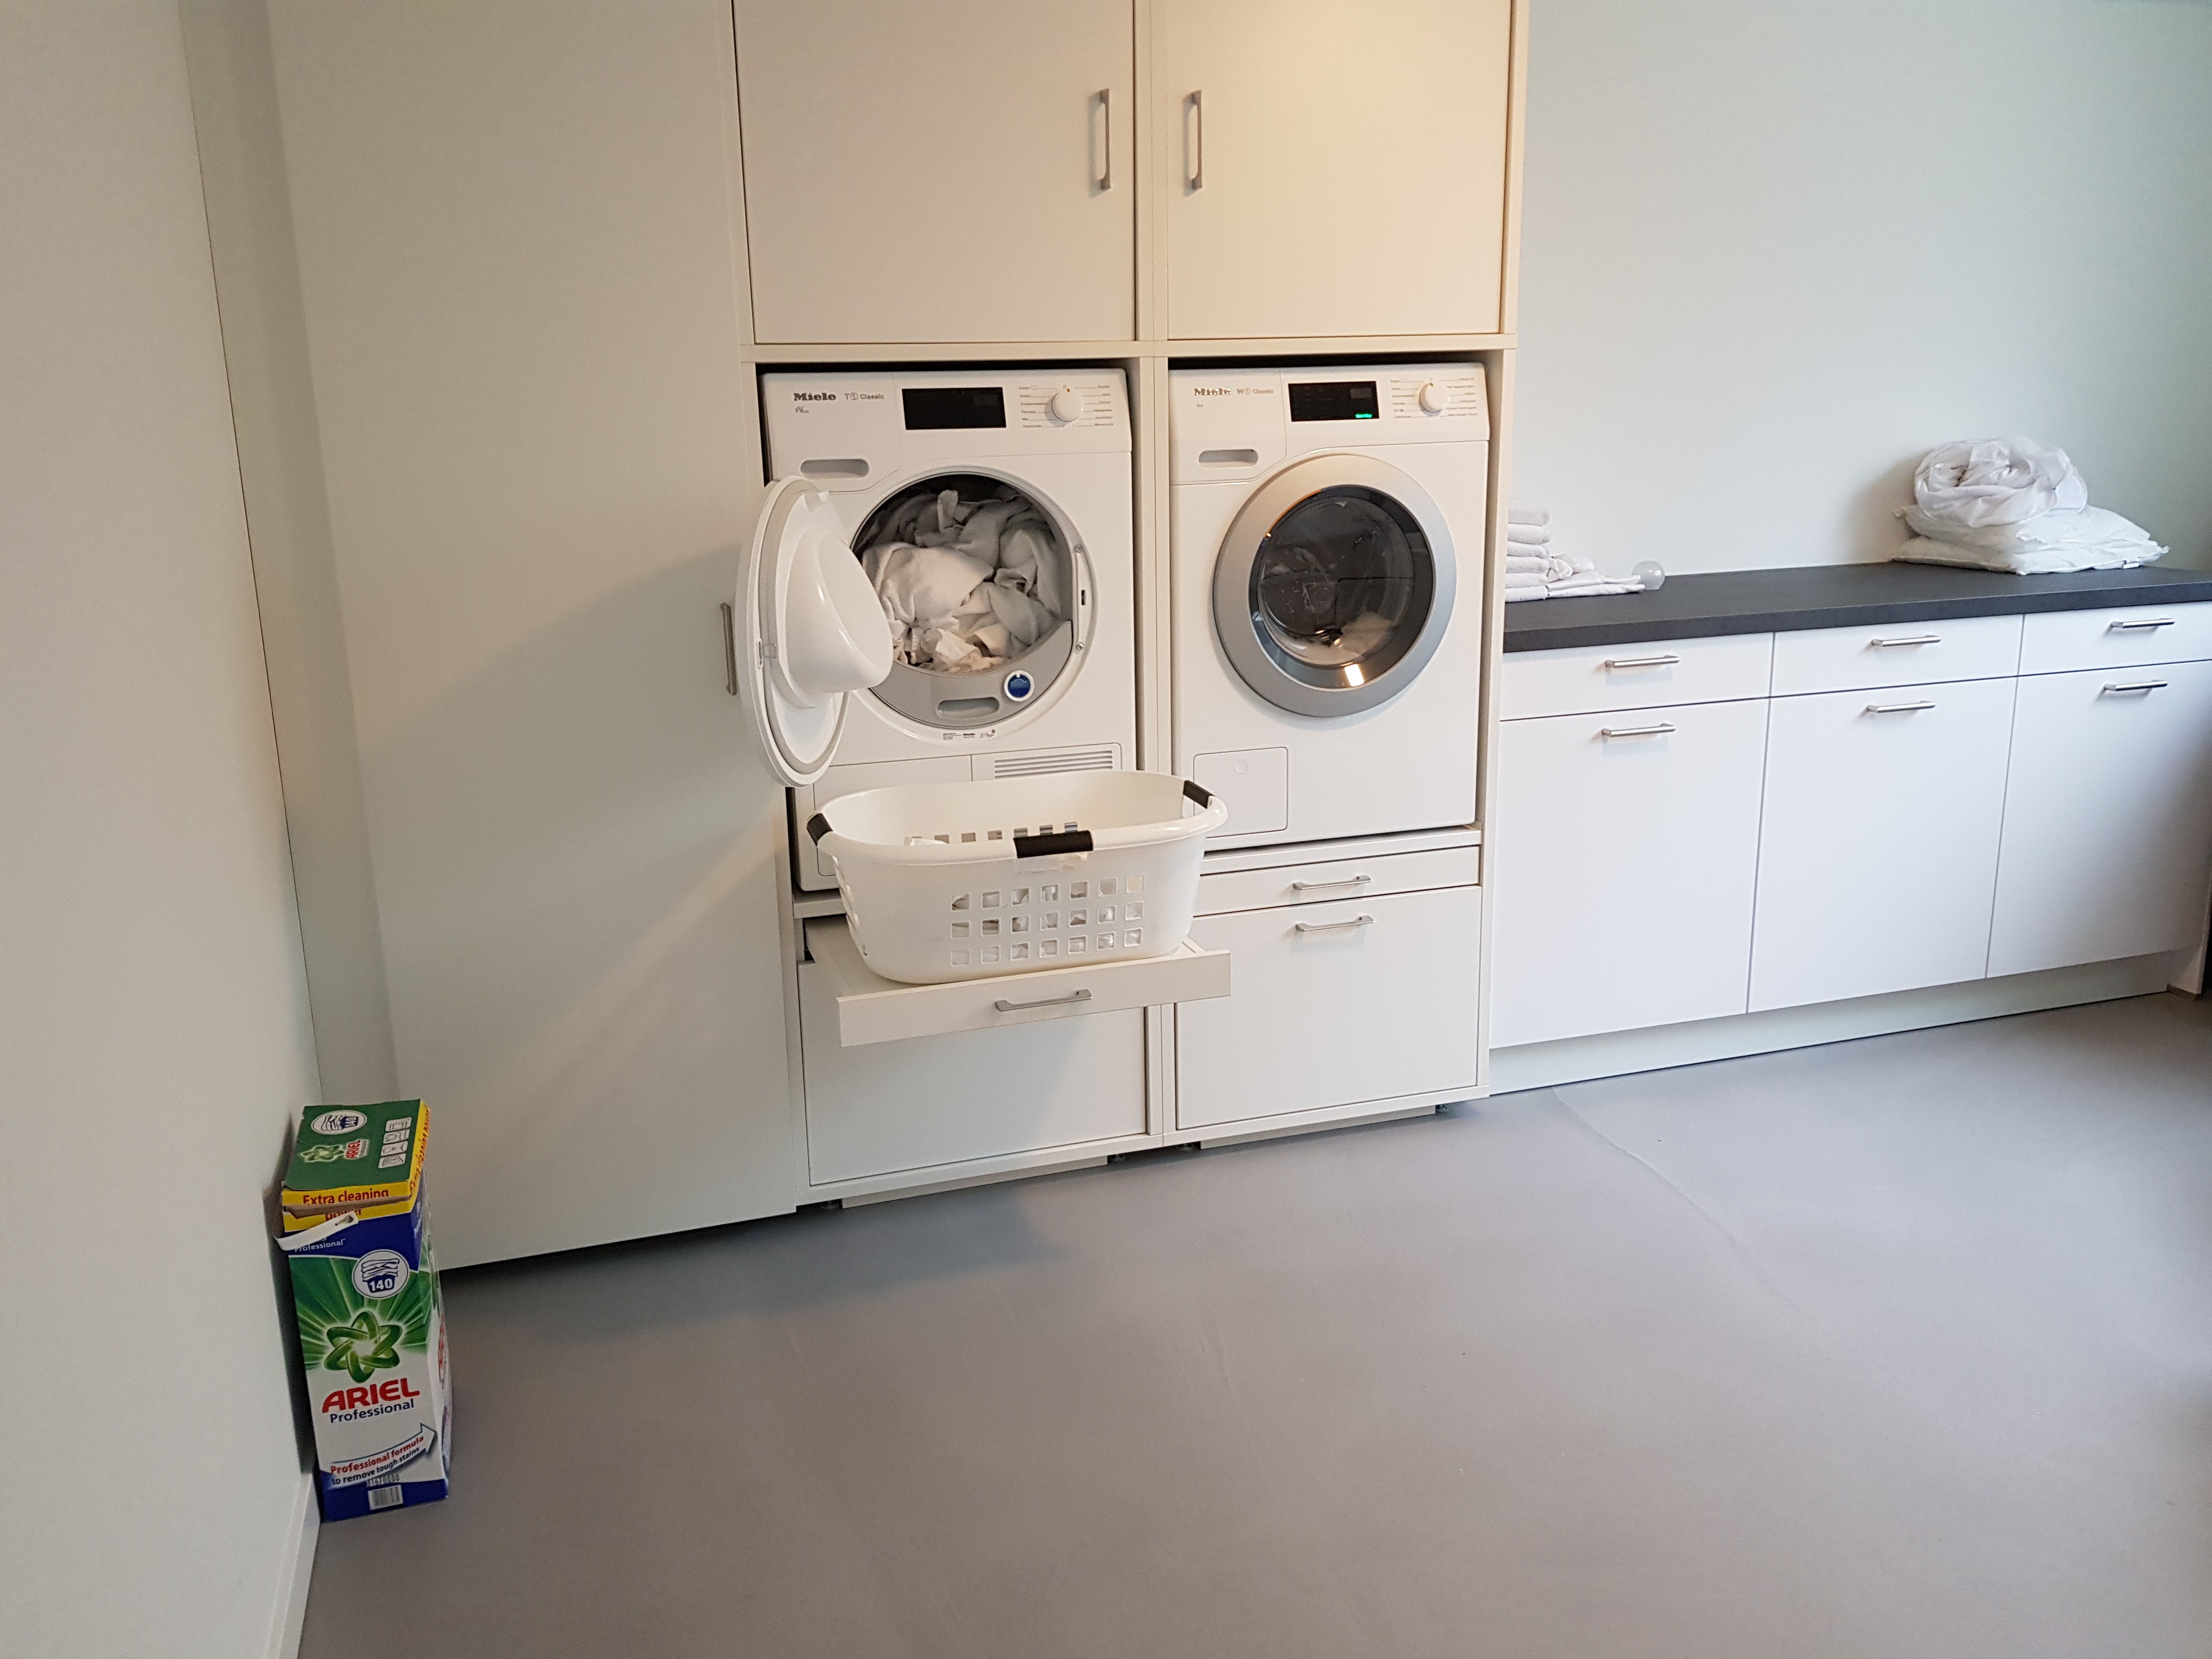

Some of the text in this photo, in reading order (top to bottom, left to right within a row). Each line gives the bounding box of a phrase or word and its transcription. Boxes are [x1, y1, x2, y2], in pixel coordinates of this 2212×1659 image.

[793, 392, 837, 401] Miele
[303, 1188, 389, 1205] Extra cleaning
[369, 1278, 393, 1291] 140
[322, 1378, 420, 1413] ARIEL
[330, 1398, 414, 1423] Professional
[331, 1435, 424, 1475] Professional formula
[343, 1469, 375, 1483] remove
[376, 1459, 398, 1473] tough
[399, 1447, 420, 1463] stains
